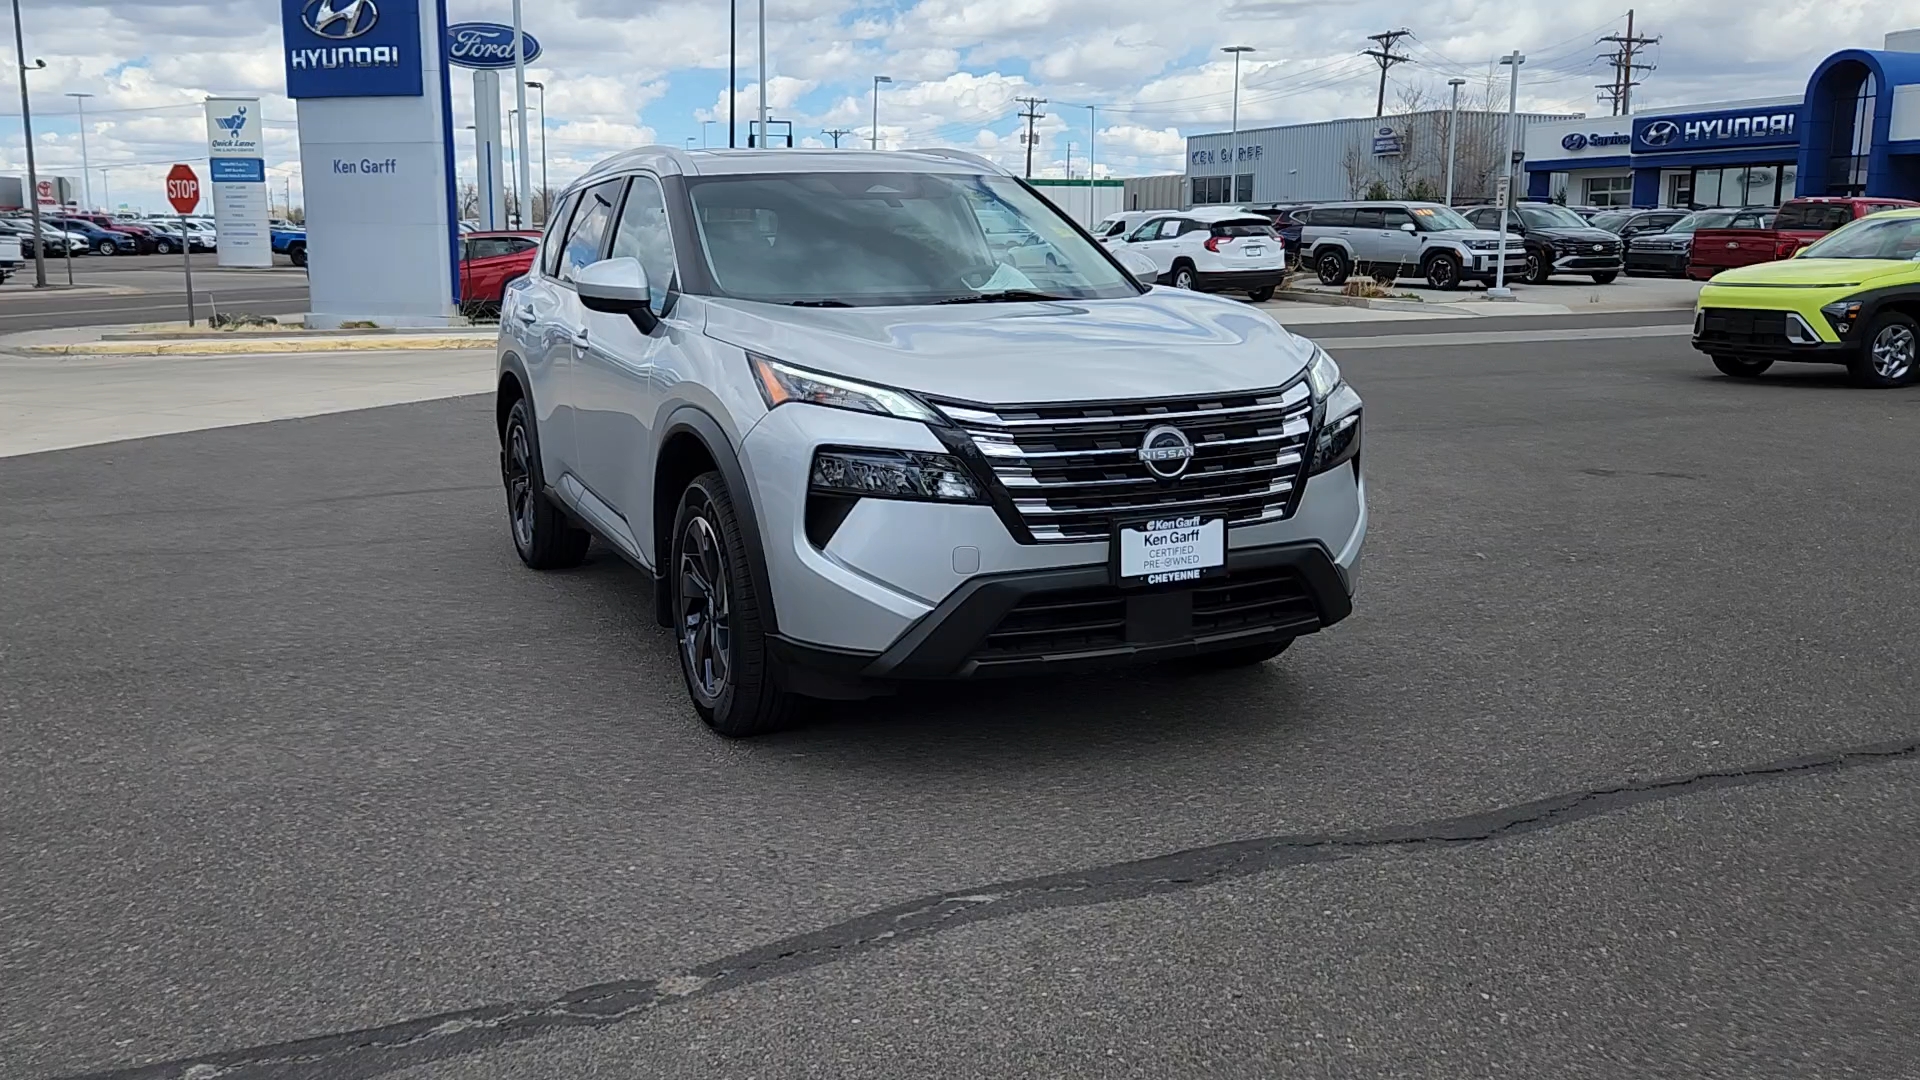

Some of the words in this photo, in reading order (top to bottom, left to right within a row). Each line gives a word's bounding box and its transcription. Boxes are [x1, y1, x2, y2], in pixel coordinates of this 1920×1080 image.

[451, 30, 516, 58] Ford
[292, 46, 399, 70] HYUNDAI
[1684, 113, 1796, 142] HYUNDAI
[212, 139, 233, 148] Quick
[234, 139, 256, 147] Lane
[1588, 131, 1631, 146] Service
[1191, 149, 1215, 165] KEN
[333, 159, 357, 174] Ken
[360, 158, 397, 174] Garff
[168, 179, 198, 199] STOP
[1140, 447, 1194, 460] NISSAN
[1155, 519, 1175, 531] Ken
[1175, 515, 1201, 528] Garff
[1144, 533, 1168, 547] Ken
[1169, 529, 1200, 544] Garff
[1149, 545, 1195, 559] CERTIFIED
[1143, 555, 1200, 570] PRE-OWNED
[1147, 569, 1201, 585] CHEYENNE
